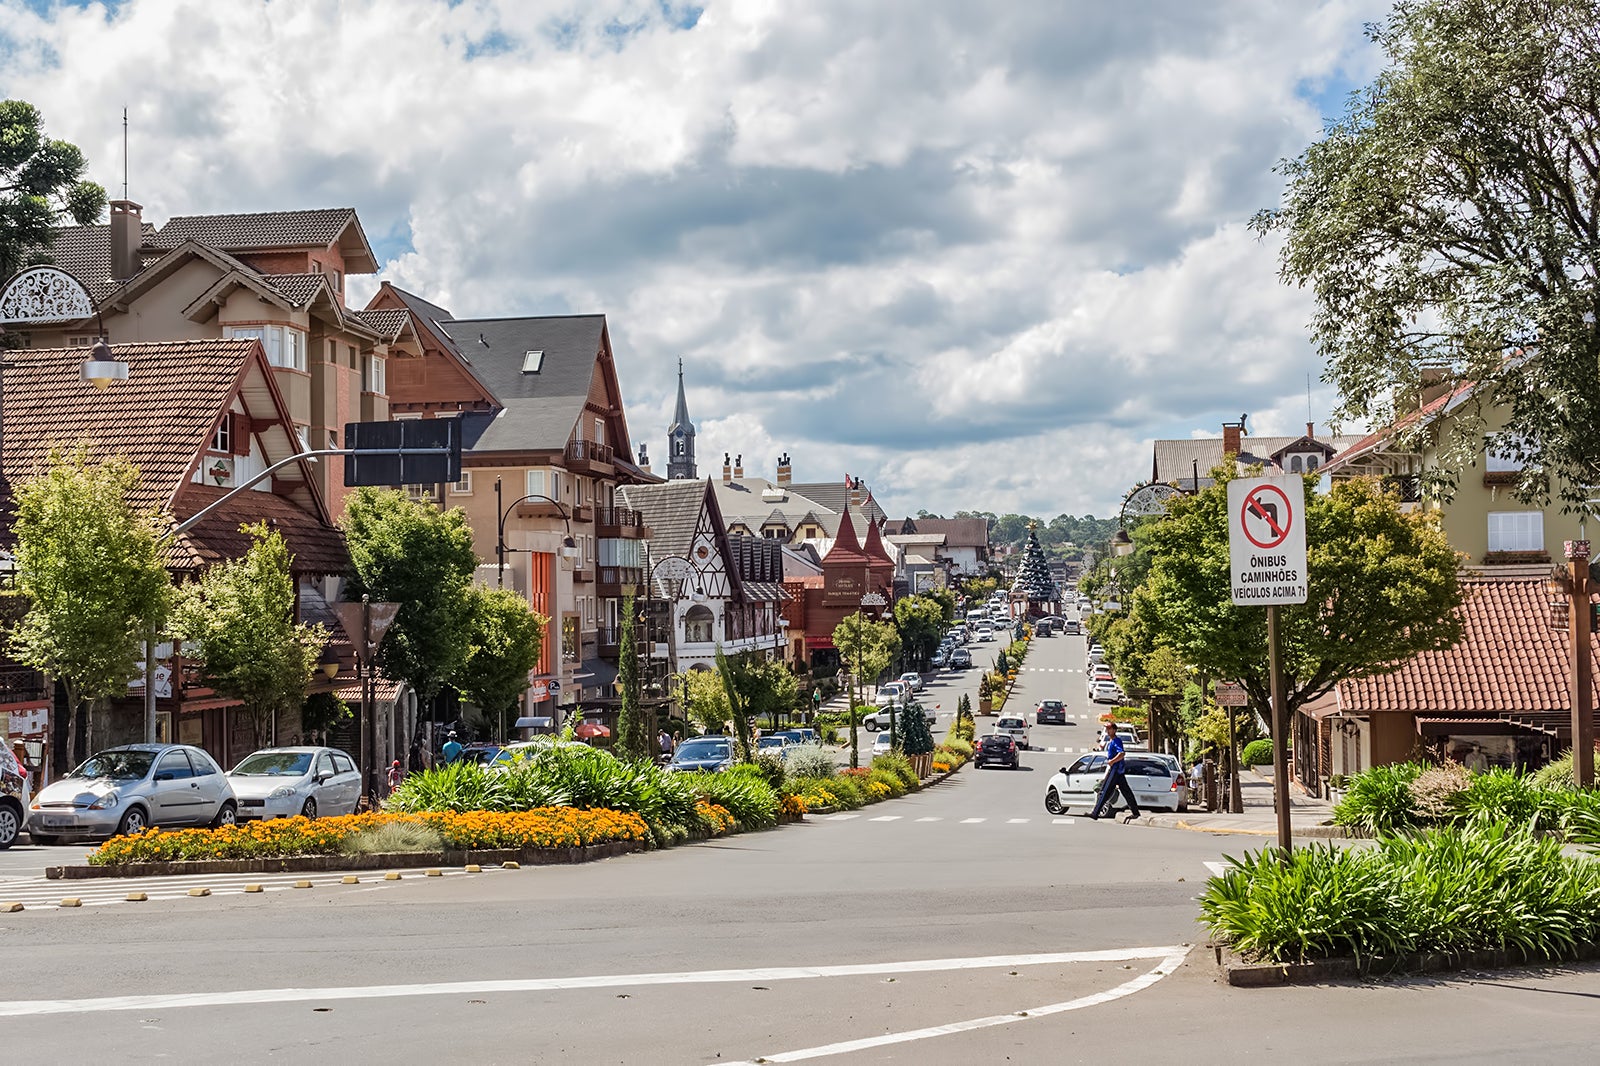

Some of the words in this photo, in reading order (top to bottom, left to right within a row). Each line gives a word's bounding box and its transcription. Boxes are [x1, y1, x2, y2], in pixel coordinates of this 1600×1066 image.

[1250, 554, 1287, 567] ÔNIBUS
[1241, 568, 1297, 583] CAMINHÕES
[1233, 585, 1271, 599] VEÍCULOS
[1272, 585, 1296, 598] ACIMA
[1297, 585, 1306, 597] 7t
